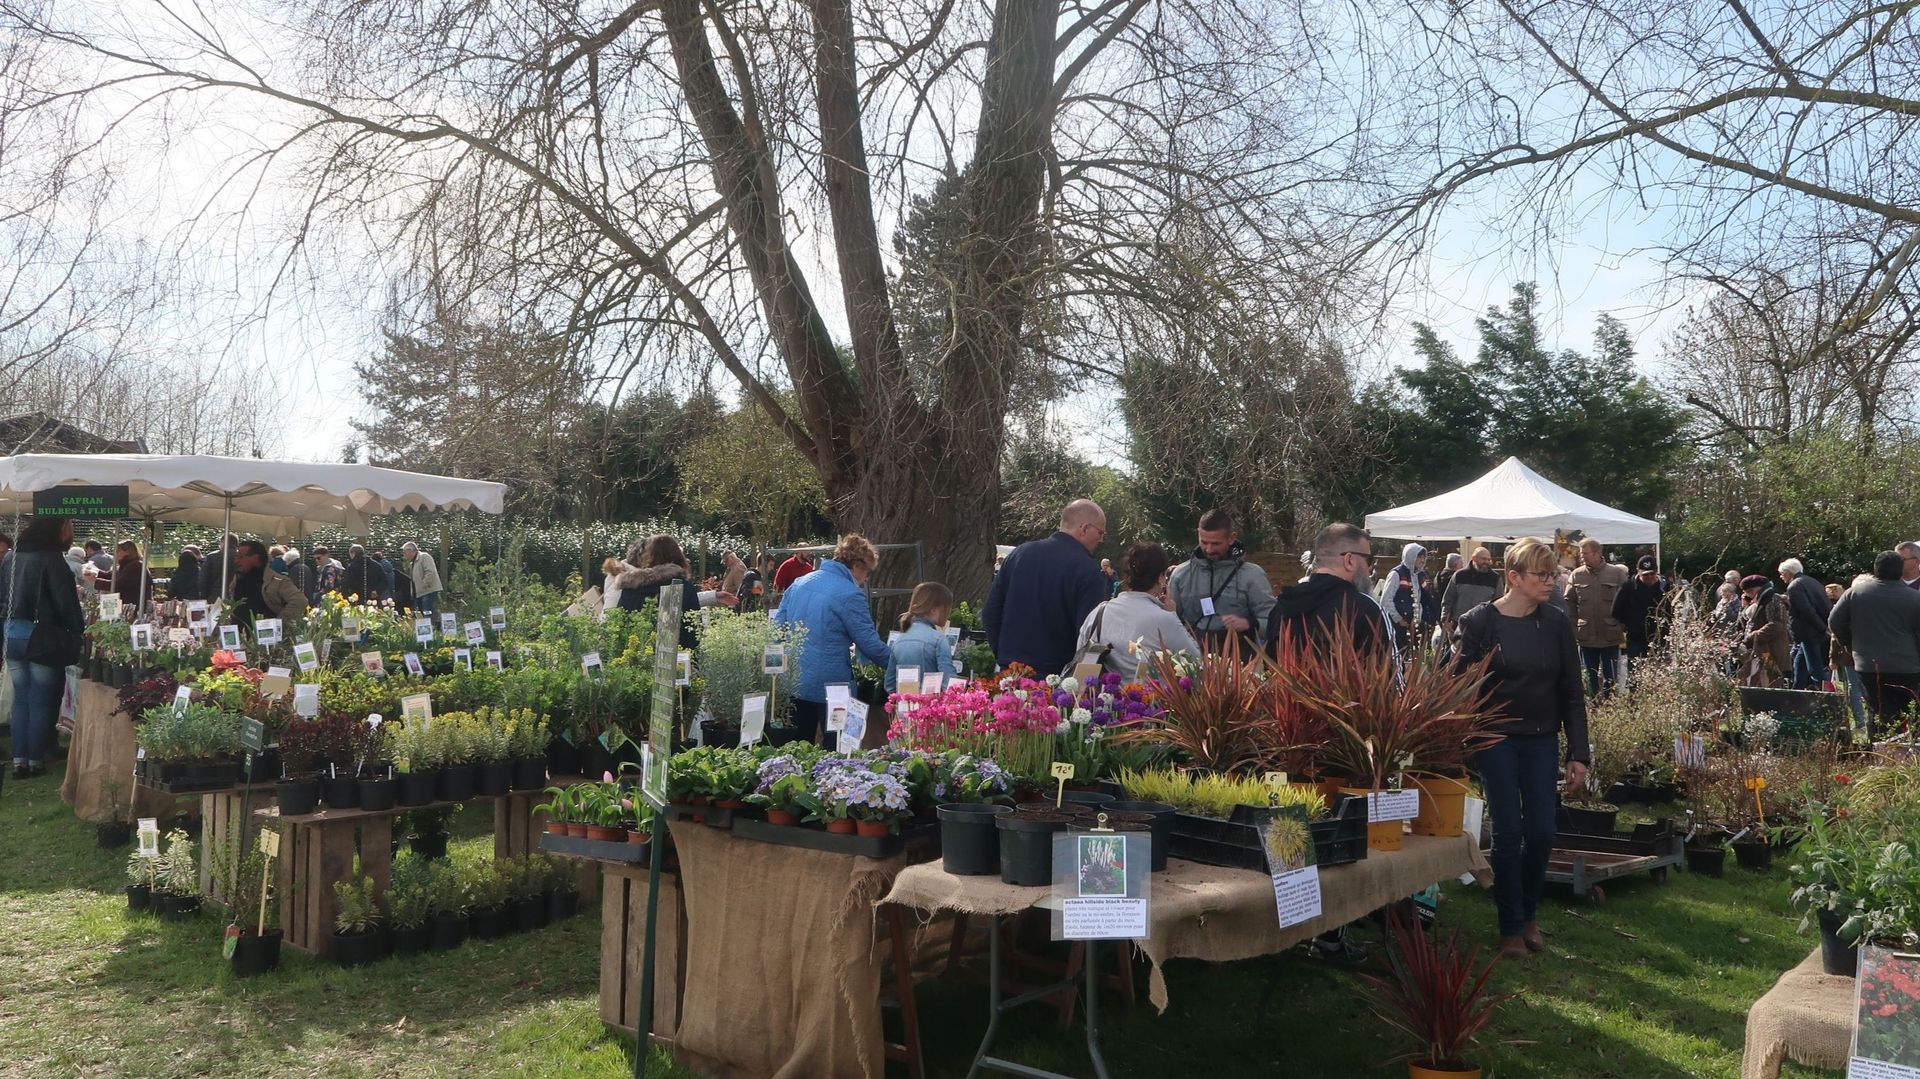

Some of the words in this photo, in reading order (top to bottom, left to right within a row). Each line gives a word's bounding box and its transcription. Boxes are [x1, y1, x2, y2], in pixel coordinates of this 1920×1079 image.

[62, 496, 103, 505] SAFRAN
[38, 507, 77, 515] BULBES
[88, 507, 127, 515] FLEURS
